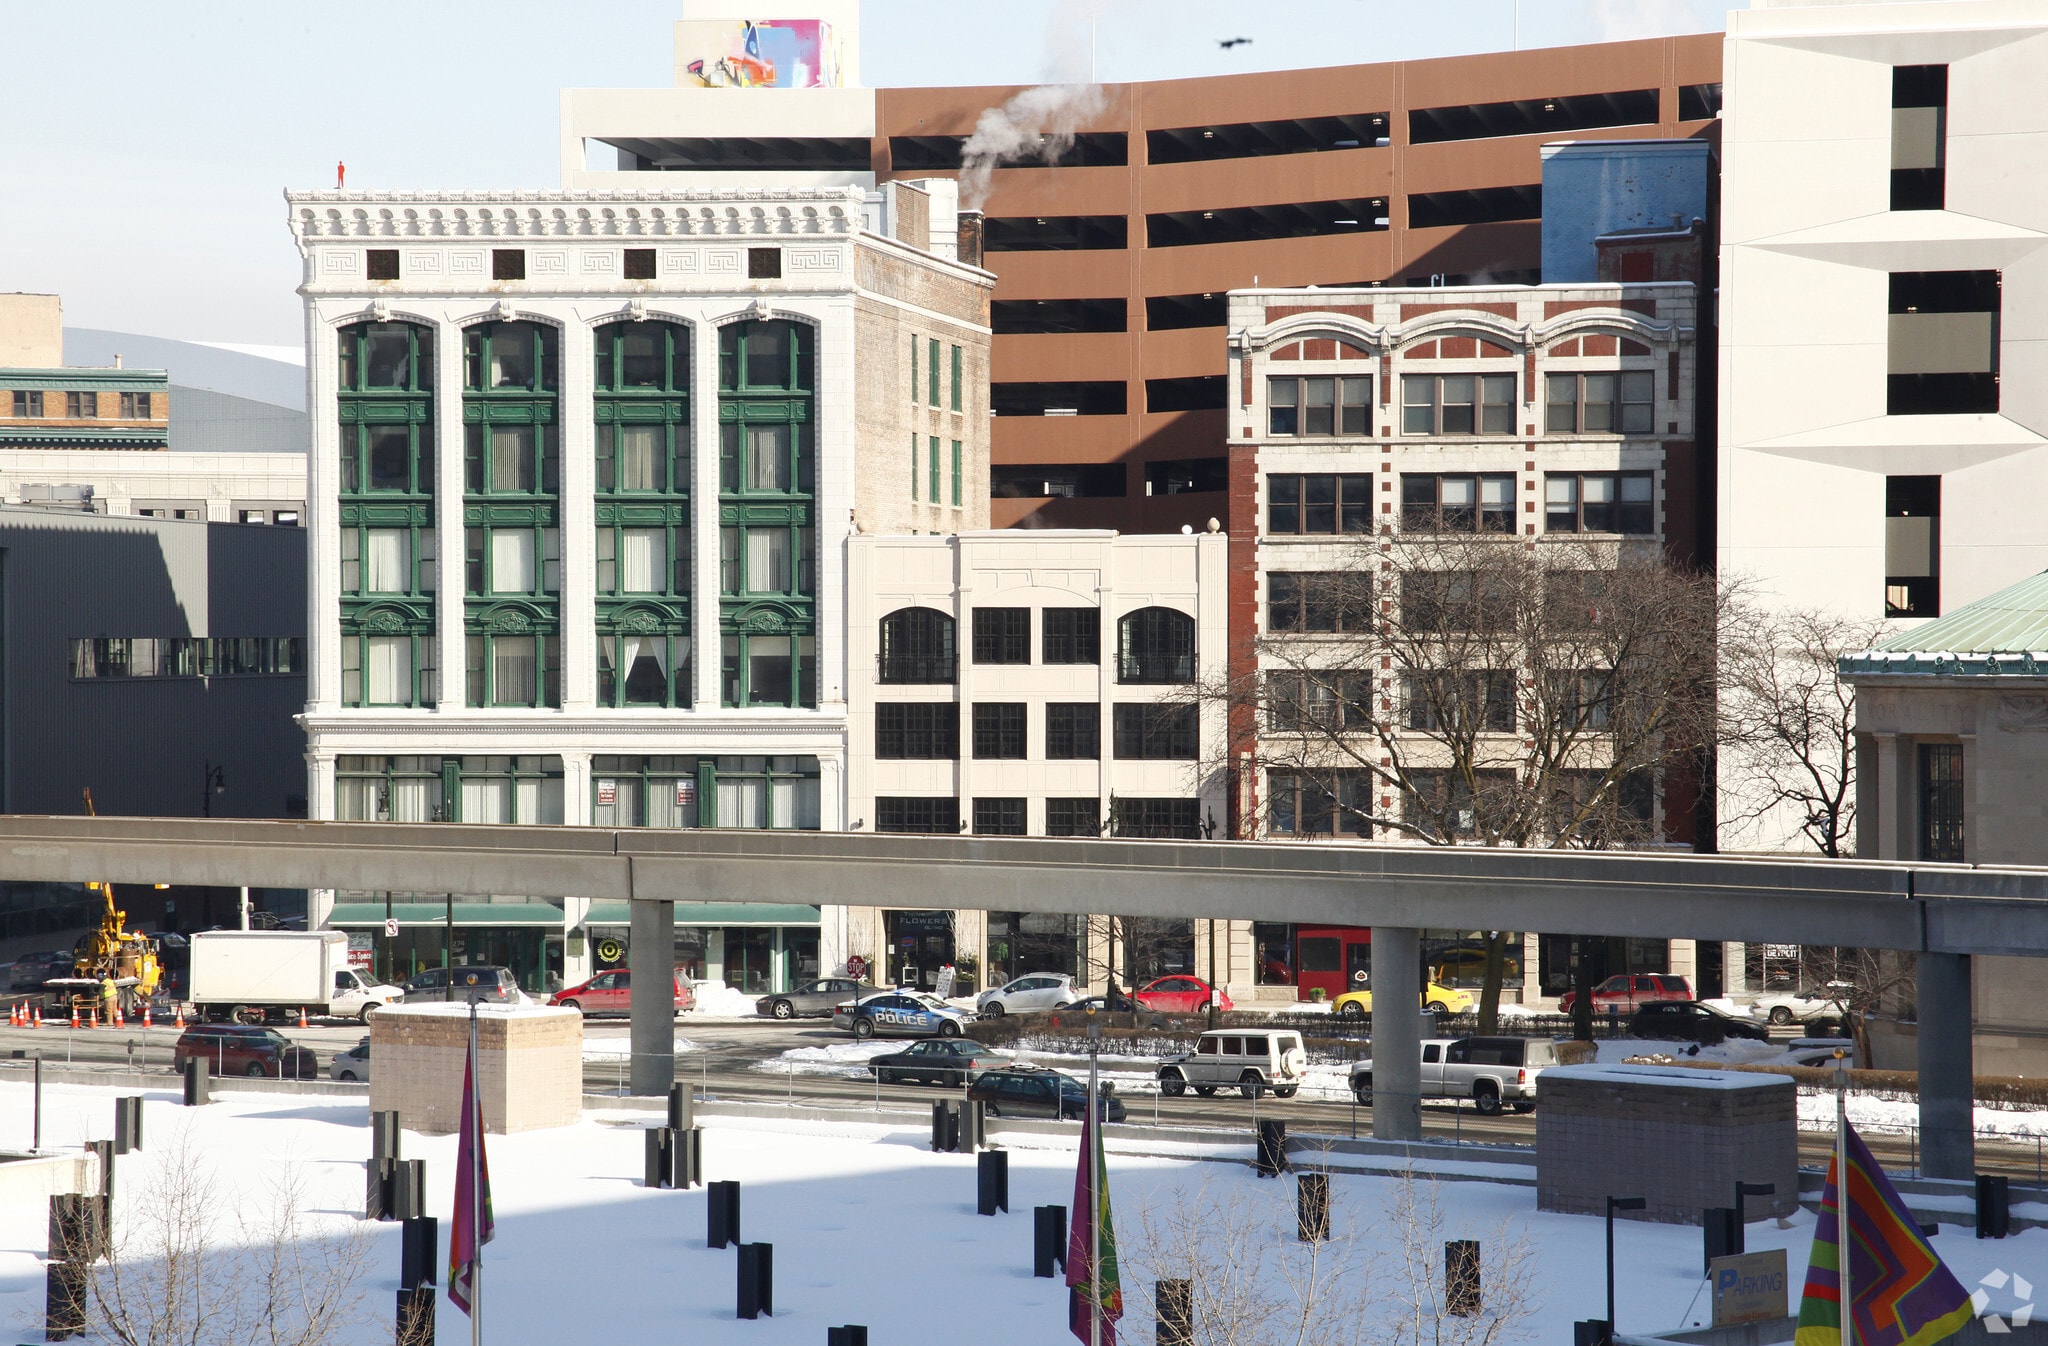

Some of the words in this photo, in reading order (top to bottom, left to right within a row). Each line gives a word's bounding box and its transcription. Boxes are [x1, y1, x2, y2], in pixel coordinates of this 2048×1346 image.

[848, 962, 864, 973] STOP
[875, 1013, 928, 1026] POLICE
[1718, 1269, 1783, 1297] PARKING
